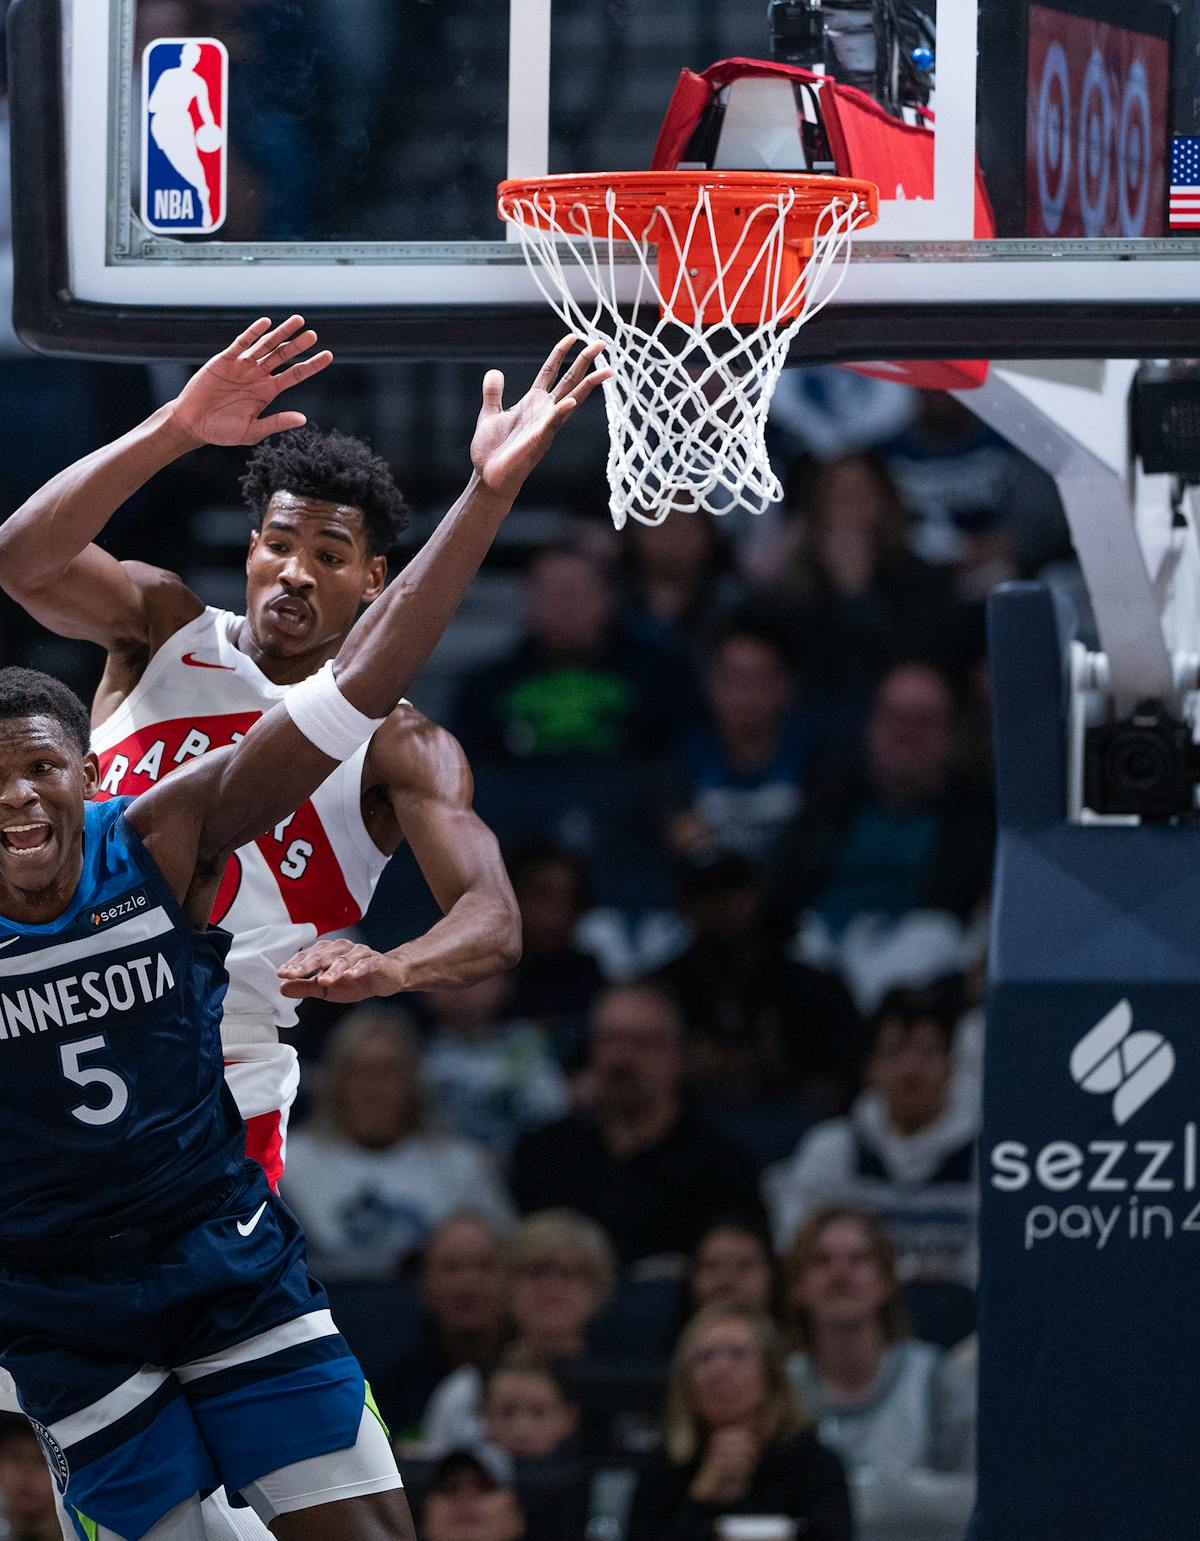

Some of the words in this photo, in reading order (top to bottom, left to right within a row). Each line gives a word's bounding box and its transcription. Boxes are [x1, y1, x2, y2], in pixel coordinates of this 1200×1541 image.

[154, 189, 194, 219] NBA
[99, 727, 314, 880] RAPS
[100, 895, 147, 922] sezzle
[59, 1034, 129, 1126] 5
[990, 1121, 1196, 1191] sezzl
[1025, 1204, 1121, 1250] pay
[1129, 1194, 1173, 1239] in
